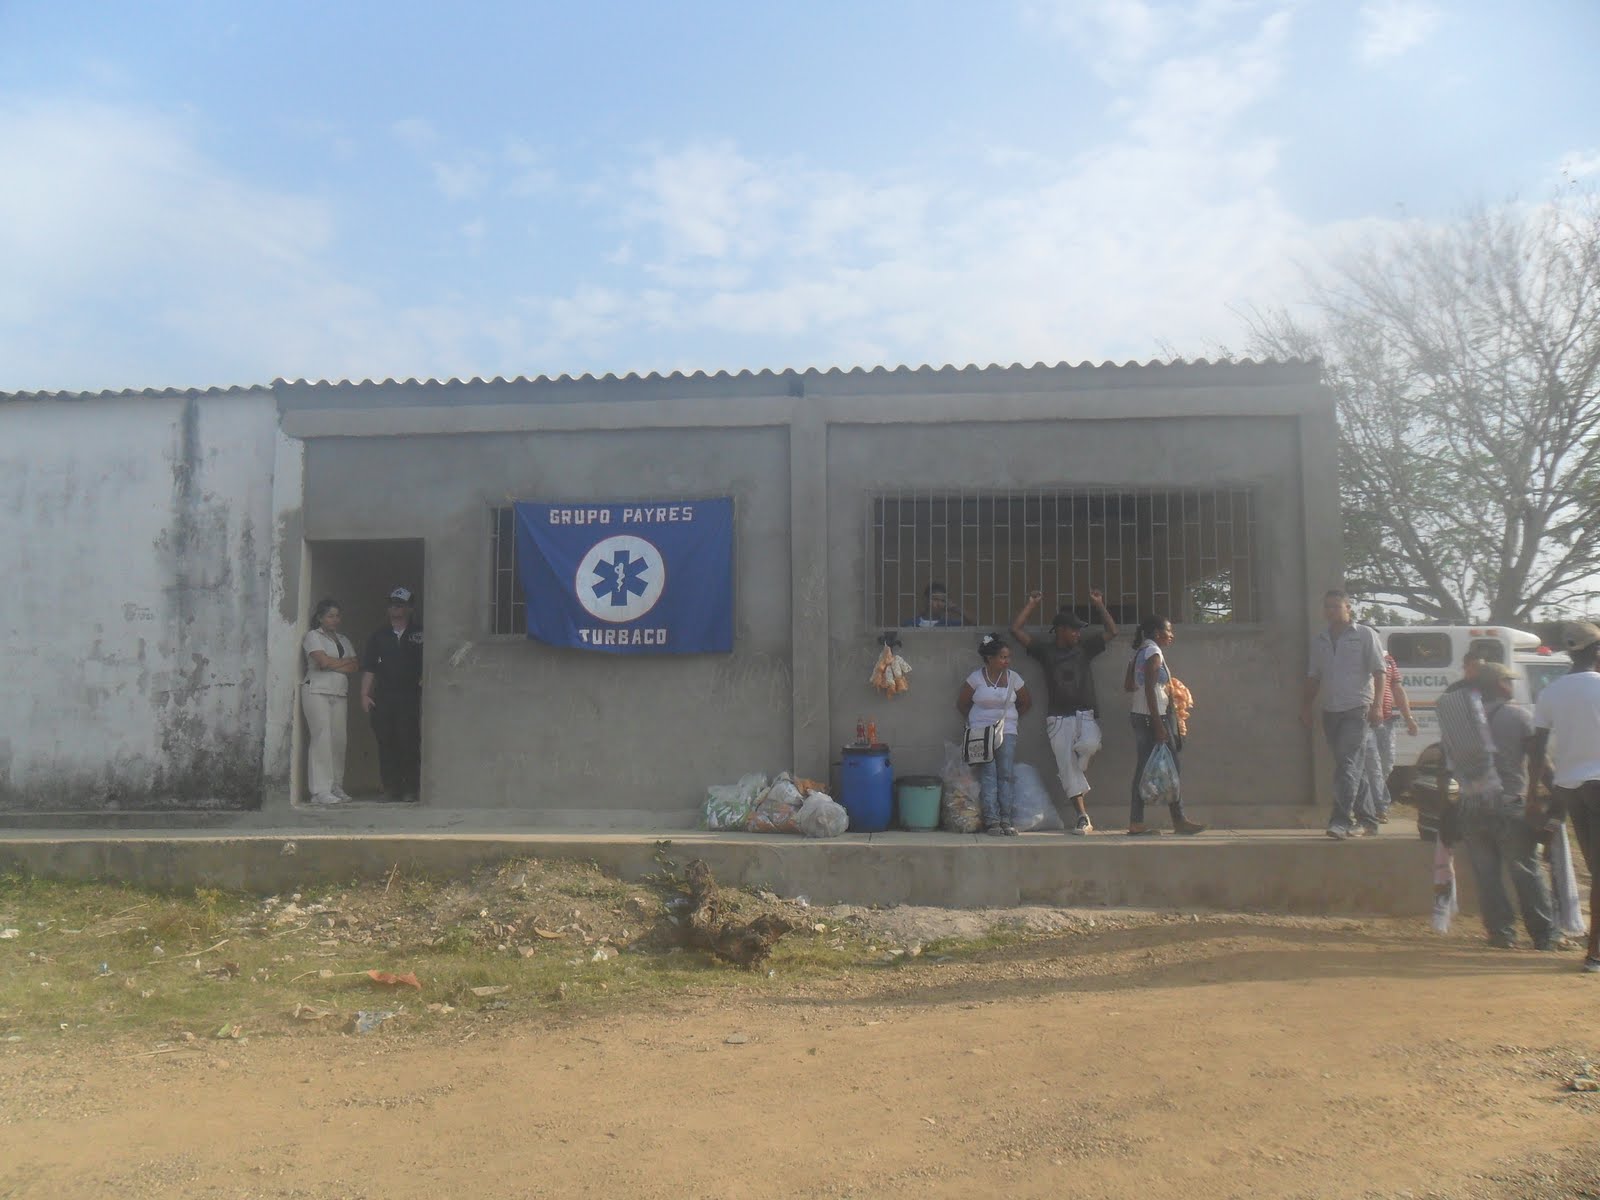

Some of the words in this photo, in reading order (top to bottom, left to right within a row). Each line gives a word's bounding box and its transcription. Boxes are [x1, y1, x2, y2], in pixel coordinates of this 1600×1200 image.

[550, 509, 611, 524] GRUPO
[623, 506, 693, 523] PAYRES
[578, 628, 667, 645] TURBACO
